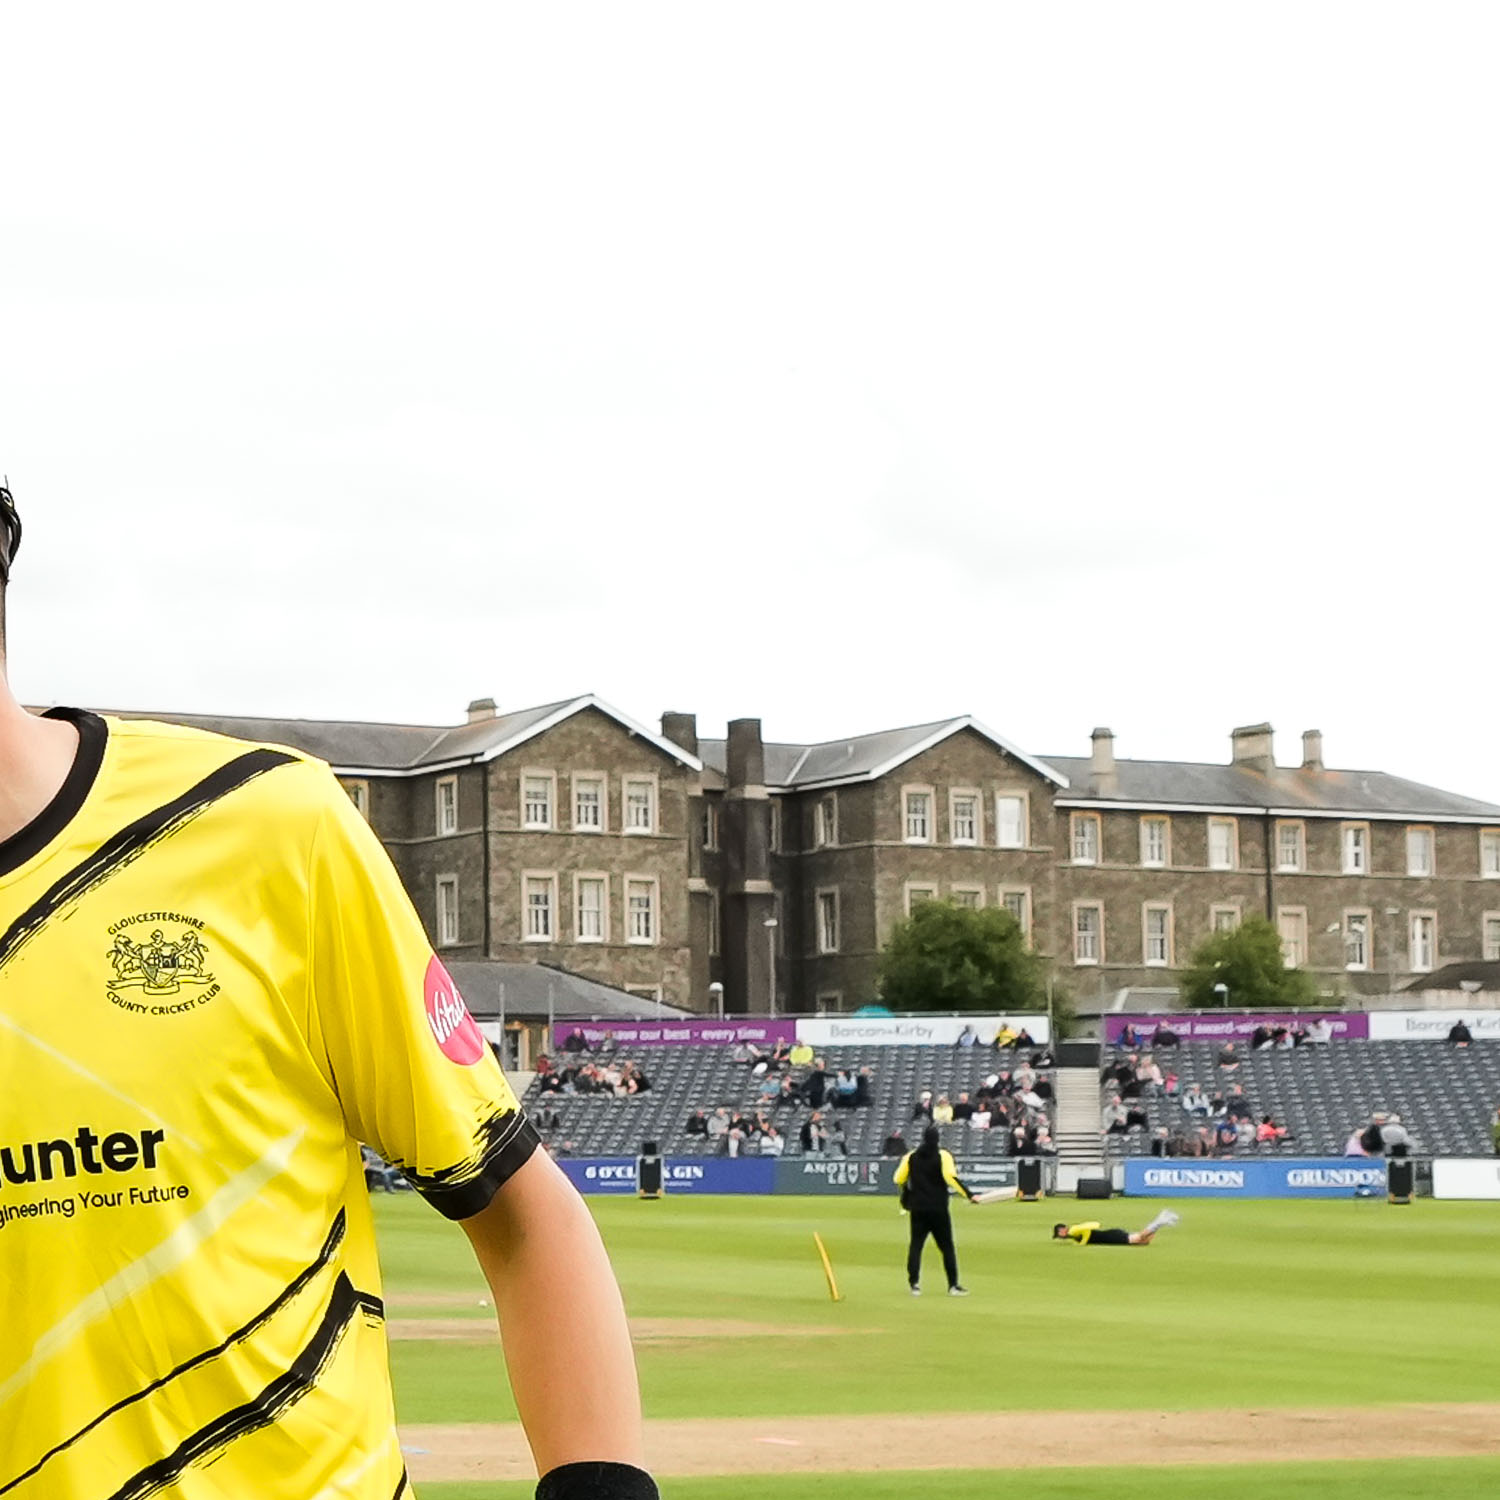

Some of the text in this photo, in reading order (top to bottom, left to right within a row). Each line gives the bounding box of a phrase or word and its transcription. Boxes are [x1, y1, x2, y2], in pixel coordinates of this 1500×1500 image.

[107, 912, 206, 935] GLOUCESTERSHIRE
[106, 983, 221, 1016] COUNTY CRICKET CLUB
[673, 1165, 704, 1179] GIN
[1144, 1169, 1245, 1187] GRUNDON
[1287, 1169, 1387, 1187] GRUNDON
[78, 1187, 124, 1212] Your
[130, 1182, 190, 1204] Future
